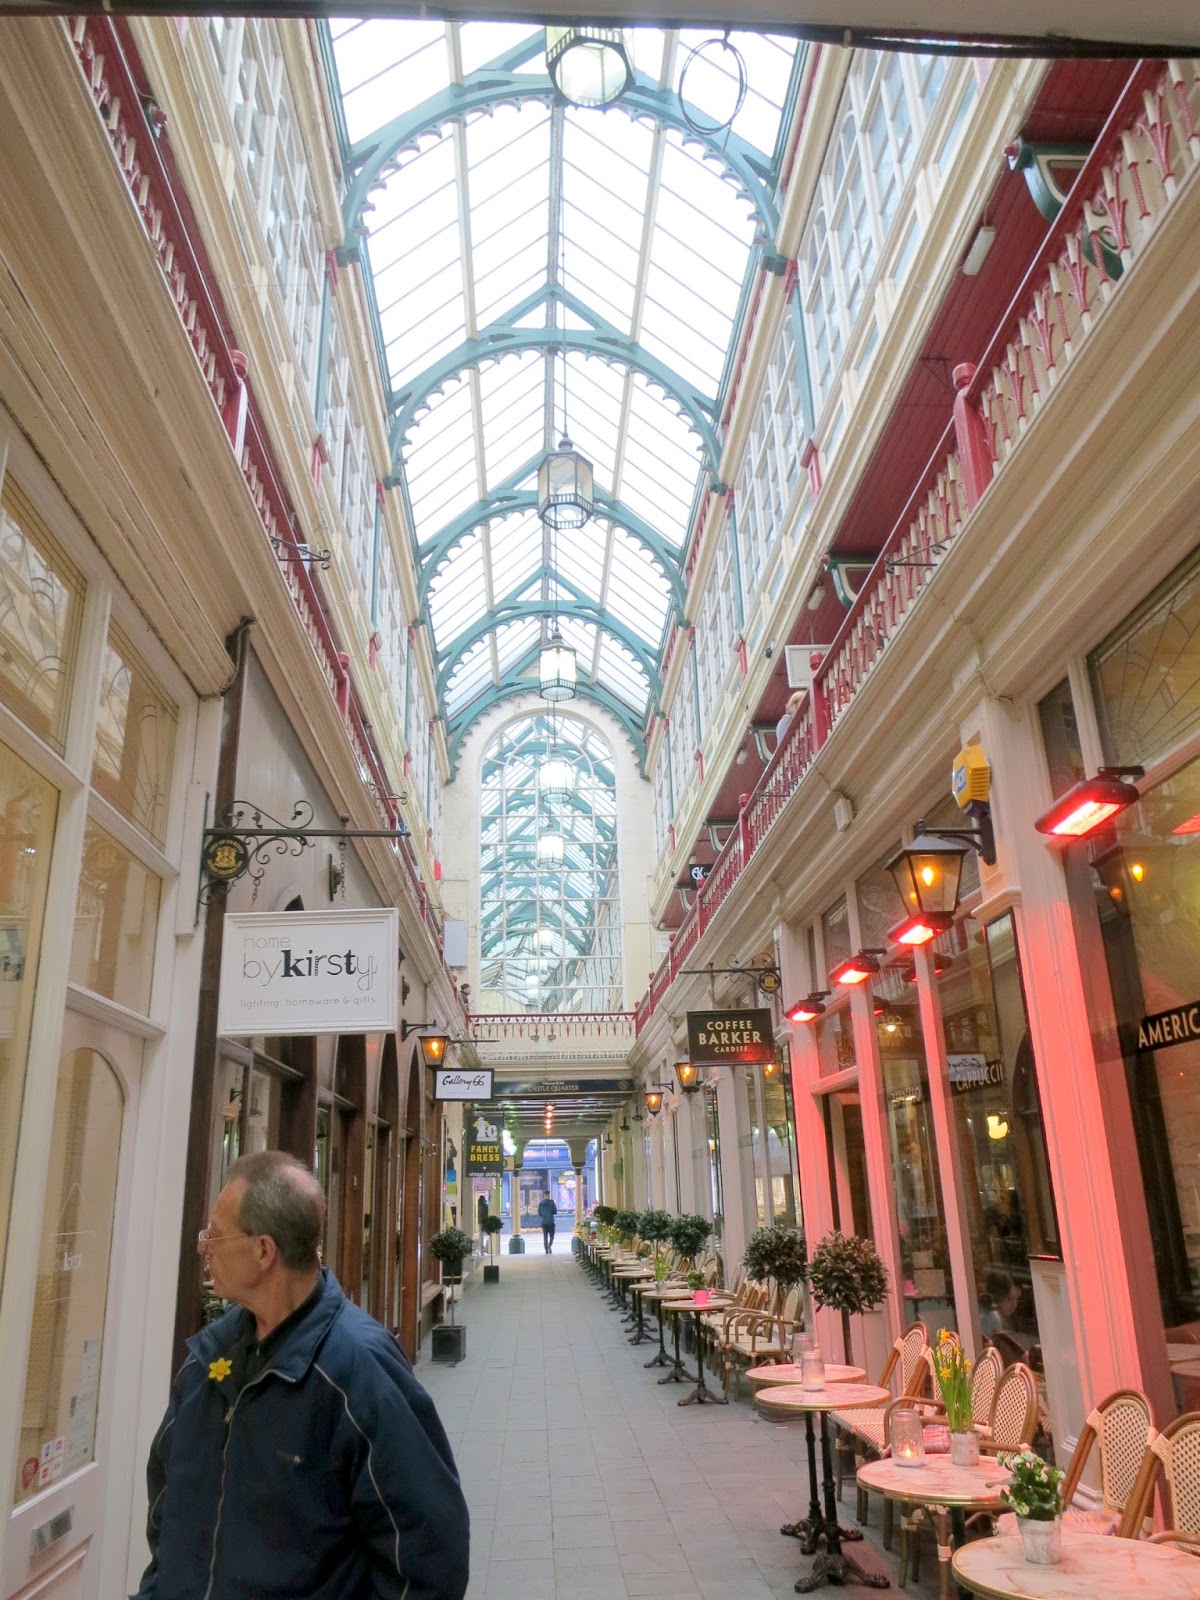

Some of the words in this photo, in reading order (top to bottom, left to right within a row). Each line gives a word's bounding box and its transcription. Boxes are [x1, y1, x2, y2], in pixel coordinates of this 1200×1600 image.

[243, 934, 292, 950] home
[285, 996, 340, 1007] homeware
[353, 995, 376, 1006] gifts
[706, 1020, 753, 1031] COFFEE
[698, 1031, 762, 1046] BARKER
[714, 1045, 748, 1053] CARDIFF
[470, 1145, 500, 1153] FANCY
[470, 1153, 500, 1163] DRESS
